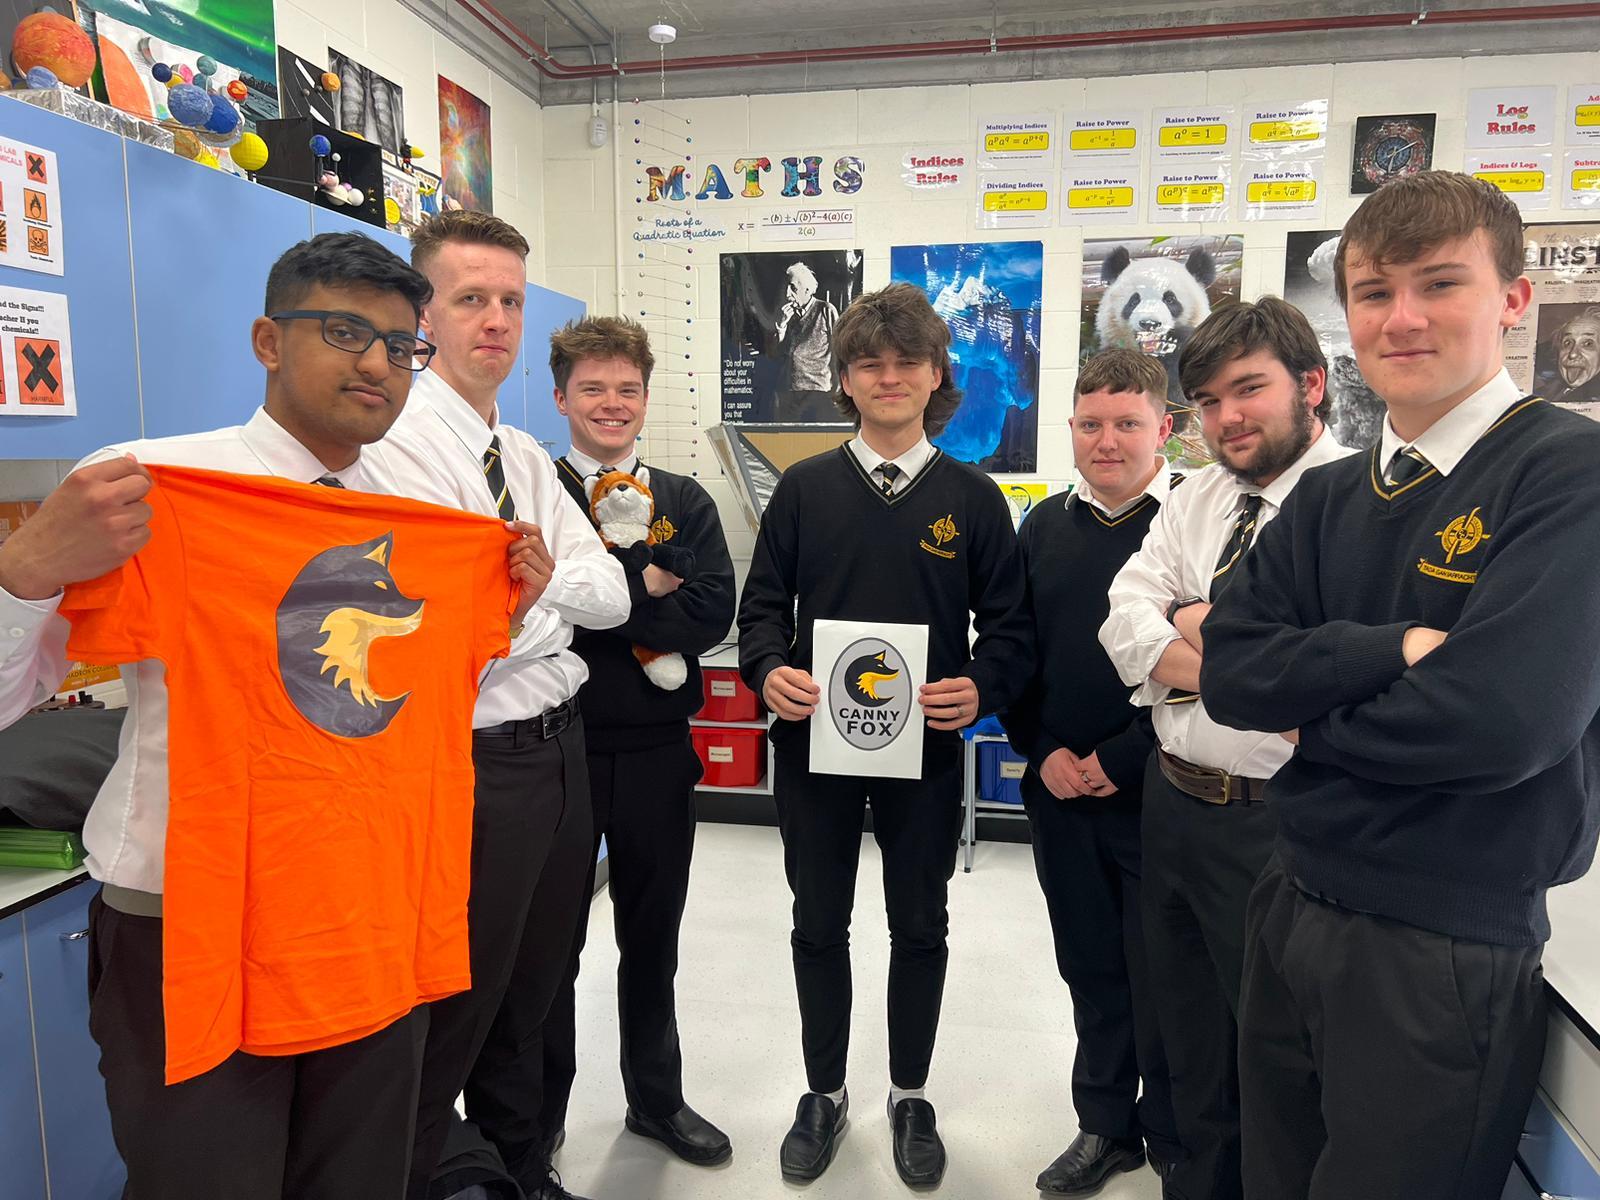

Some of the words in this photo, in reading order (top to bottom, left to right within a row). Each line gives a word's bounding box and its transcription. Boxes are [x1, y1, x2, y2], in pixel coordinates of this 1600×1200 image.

[1496, 104, 1528, 119] Log
[1487, 121, 1536, 134] Rules
[910, 156, 964, 168] Indices
[646, 156, 865, 201] MATHS
[916, 172, 958, 185] Rules
[655, 218, 682, 228] Roots
[683, 217, 694, 228] of
[633, 230, 681, 241] Quadratic
[682, 228, 726, 240] Equation
[8, 301, 19, 309] the
[723, 377, 746, 385] difficulties
[839, 708, 900, 721] CANNY
[847, 721, 893, 737] FOX
